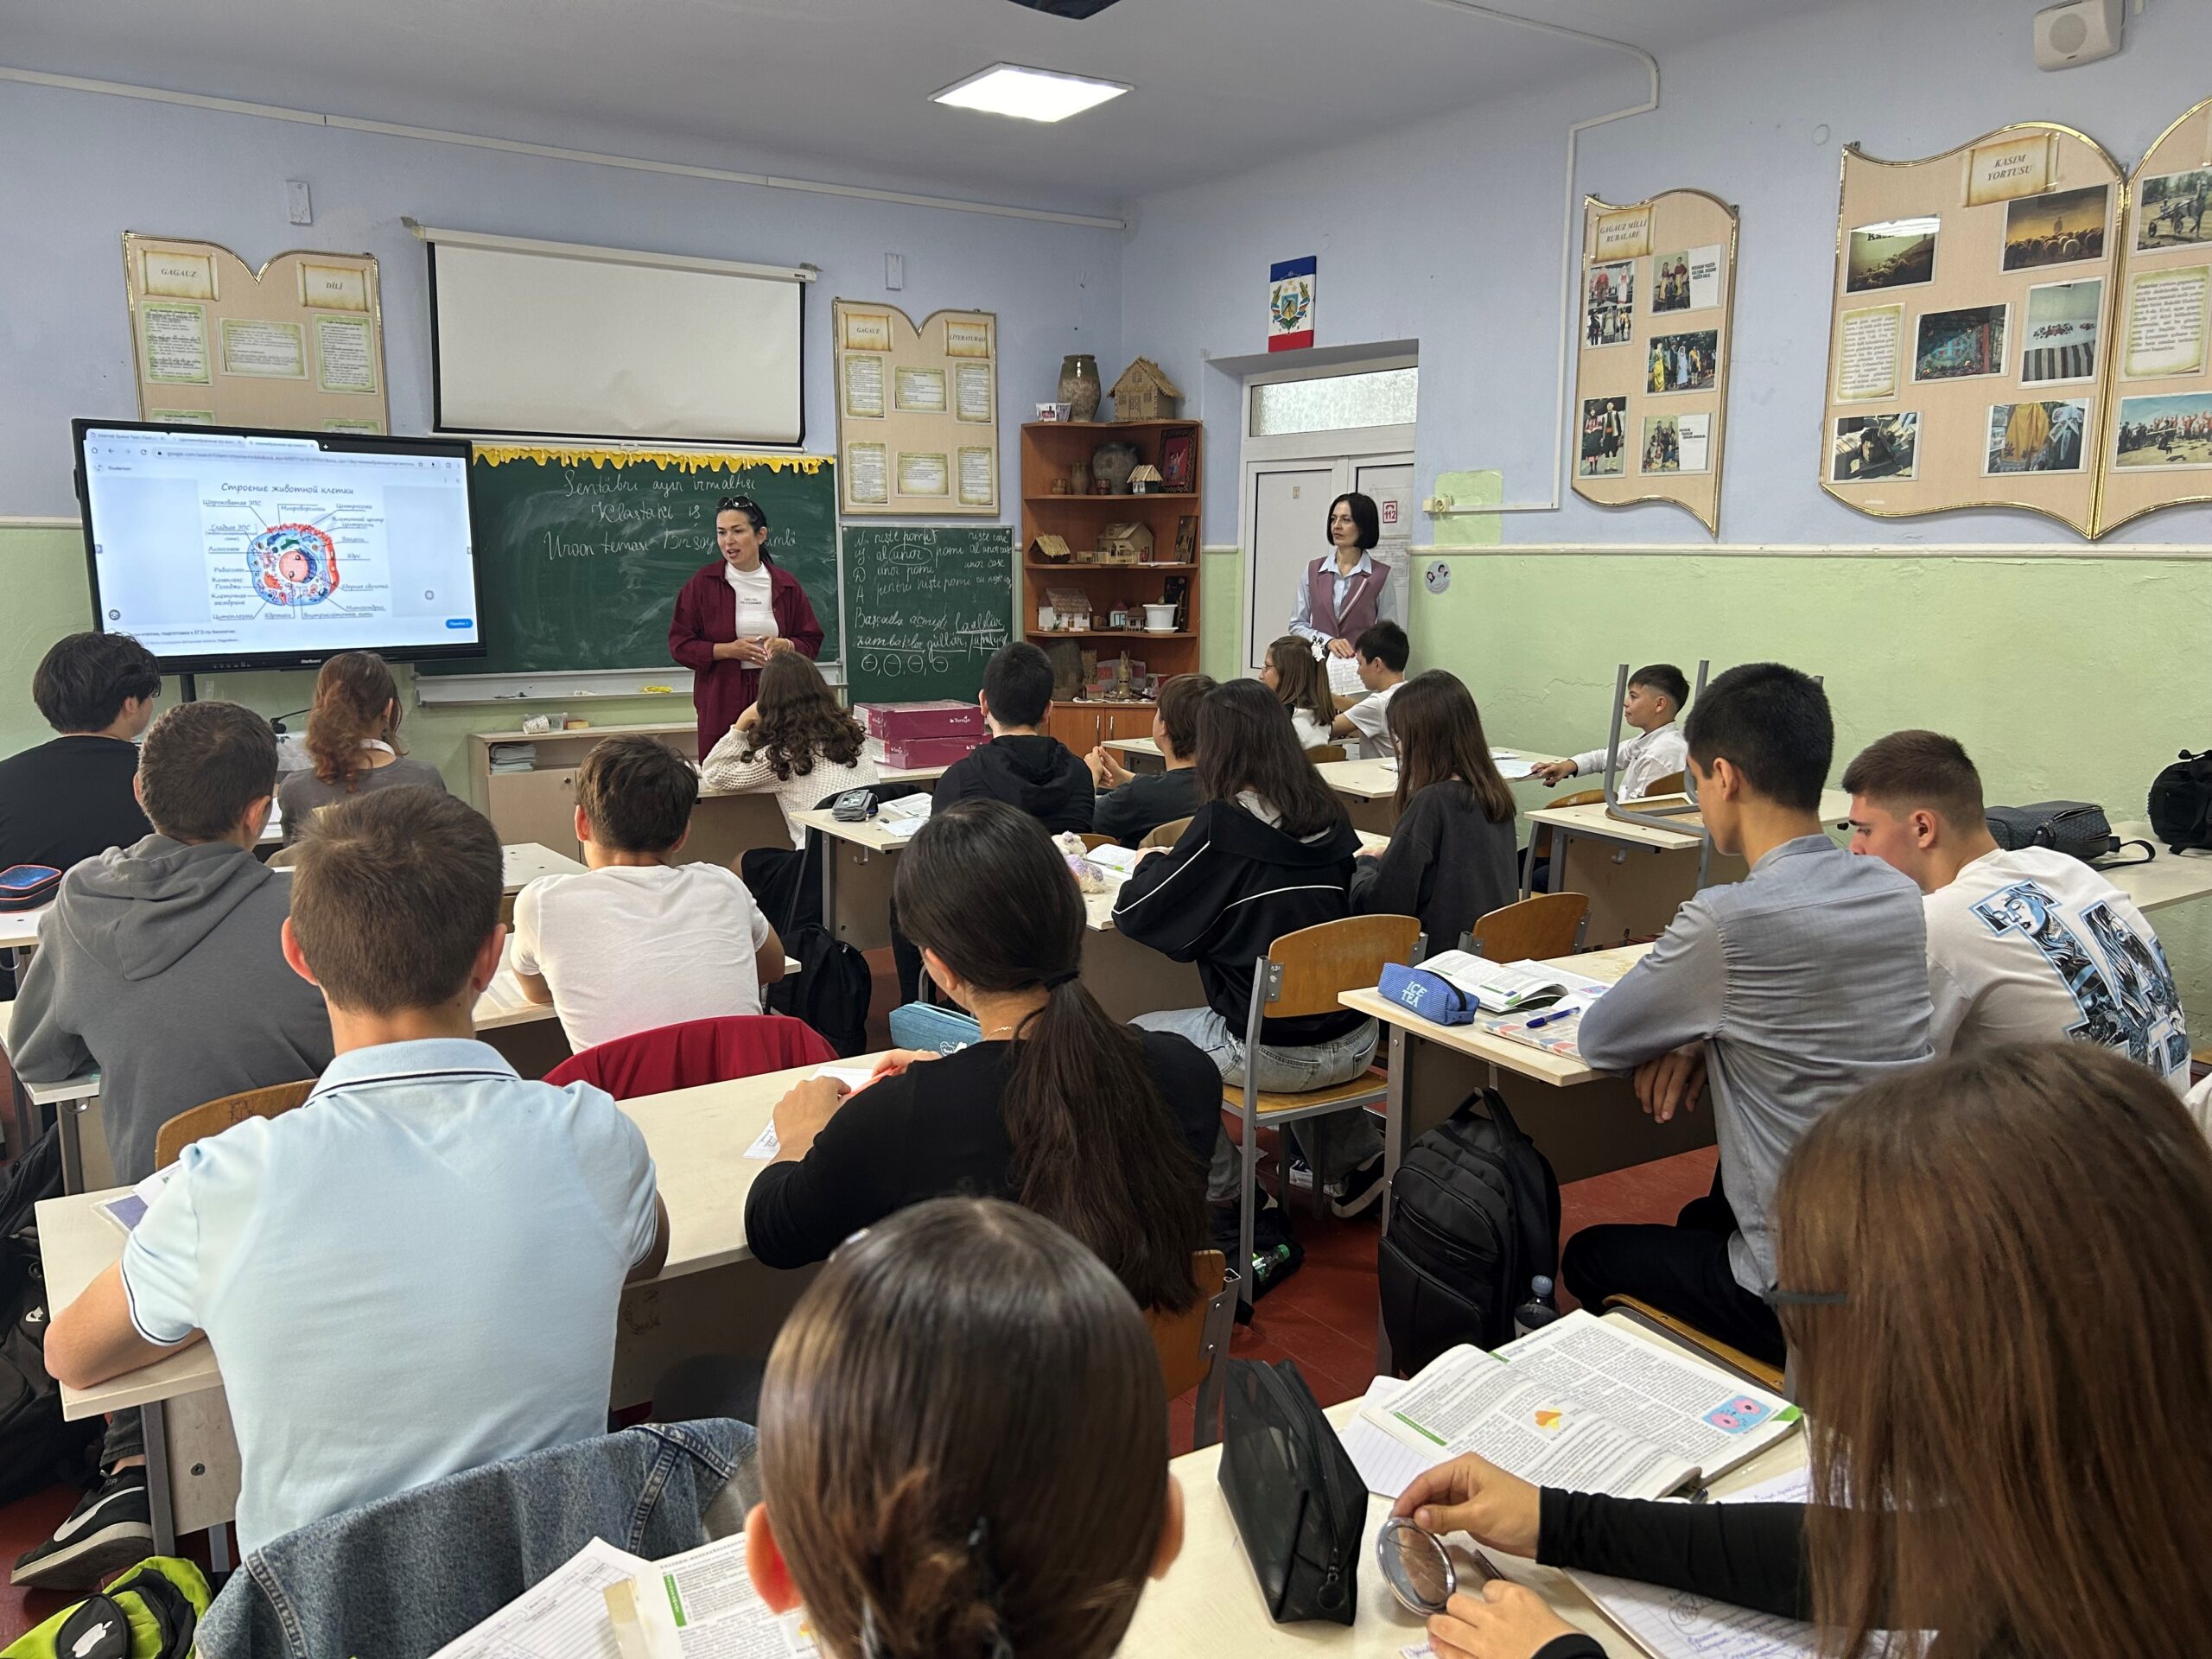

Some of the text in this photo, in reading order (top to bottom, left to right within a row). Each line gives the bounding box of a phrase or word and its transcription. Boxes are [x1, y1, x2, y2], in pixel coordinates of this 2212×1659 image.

[1994, 154, 2026, 168] KASIM
[1987, 165, 2032, 181] YORTUSU
[1599, 223, 1626, 234] GAGAUZ
[162, 268, 197, 278] GAGAUZ
[221, 483, 268, 493] Строение
[271, 485, 318, 494] животной
[1384, 511, 1396, 520] 112
[1406, 981, 1427, 997] ICE
[1401, 989, 1418, 1008] TEA
